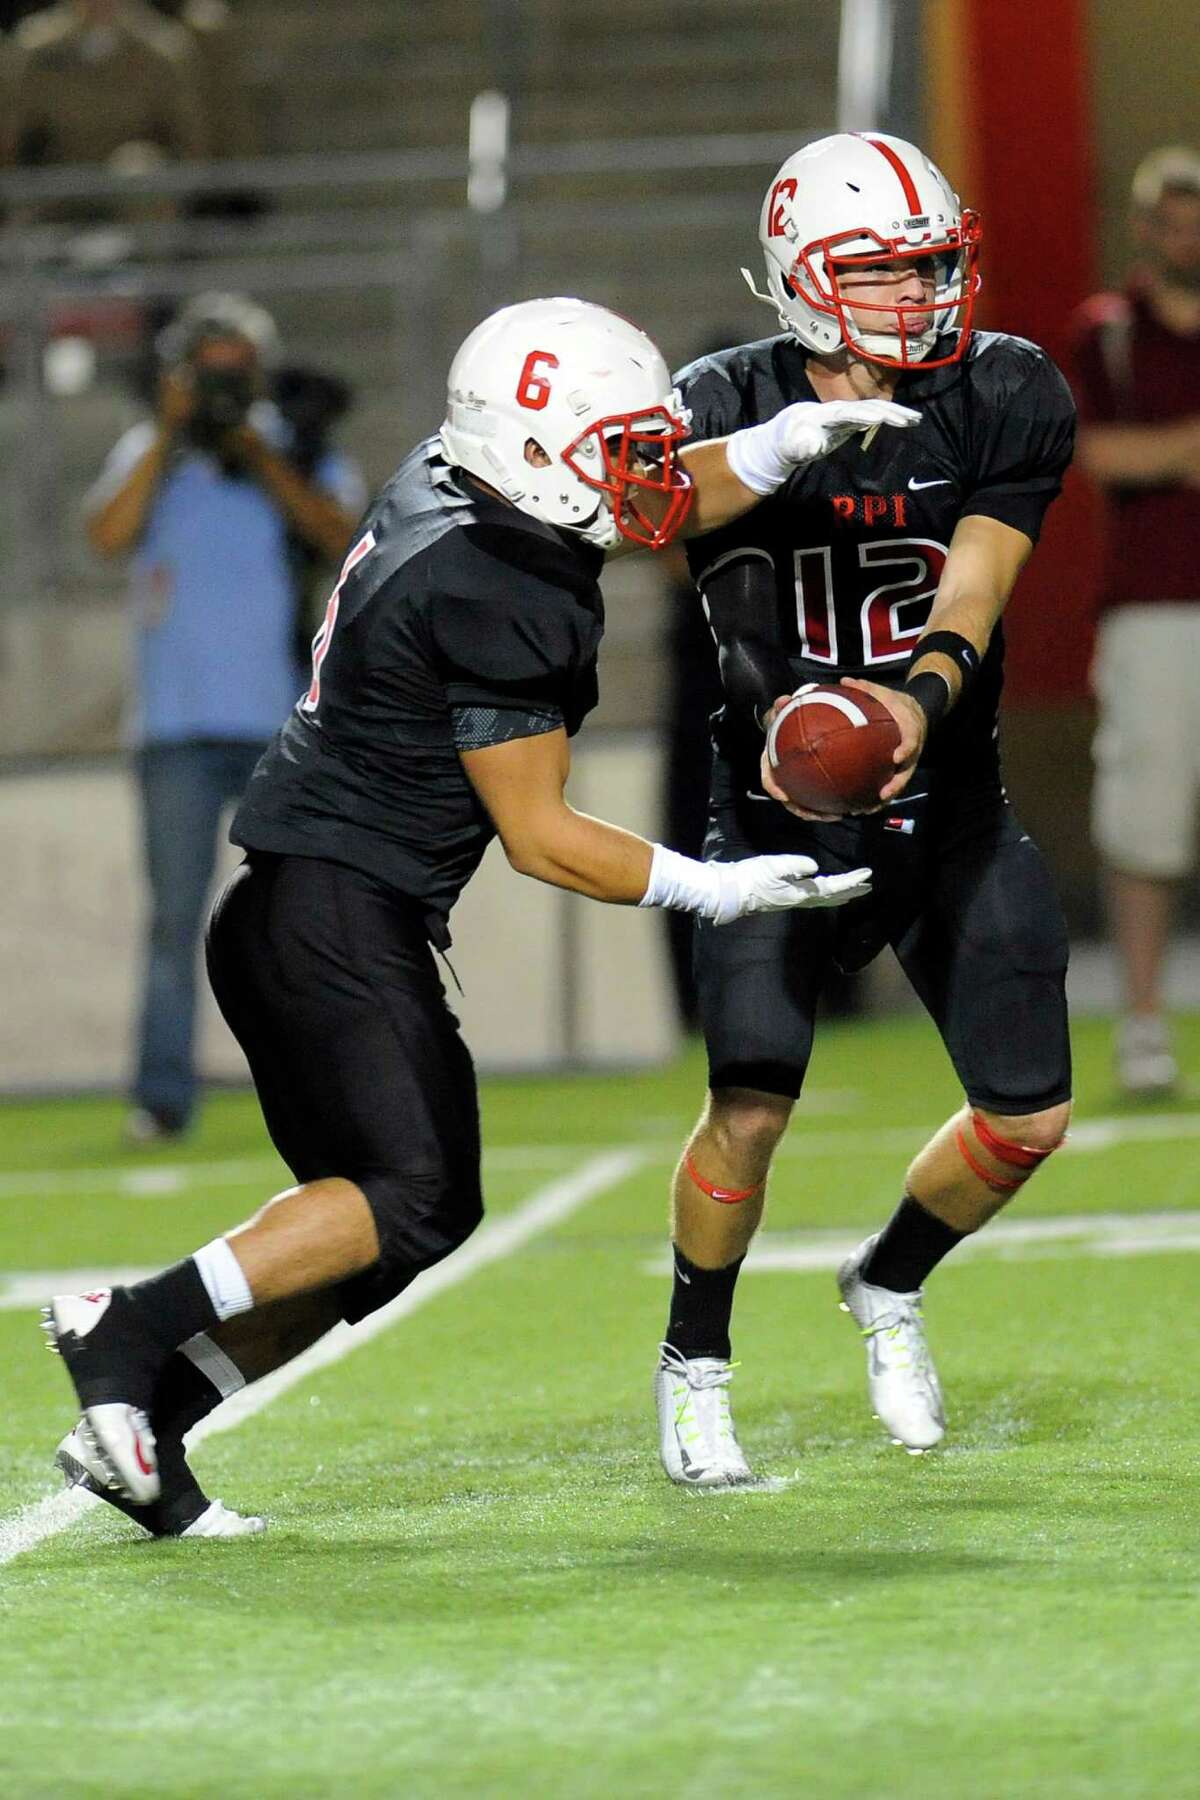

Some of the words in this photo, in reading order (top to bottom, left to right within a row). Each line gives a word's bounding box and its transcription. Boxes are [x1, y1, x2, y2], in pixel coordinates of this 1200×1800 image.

[516, 350, 560, 411] 6
[832, 495, 906, 527] RPI
[793, 537, 950, 666] 12
